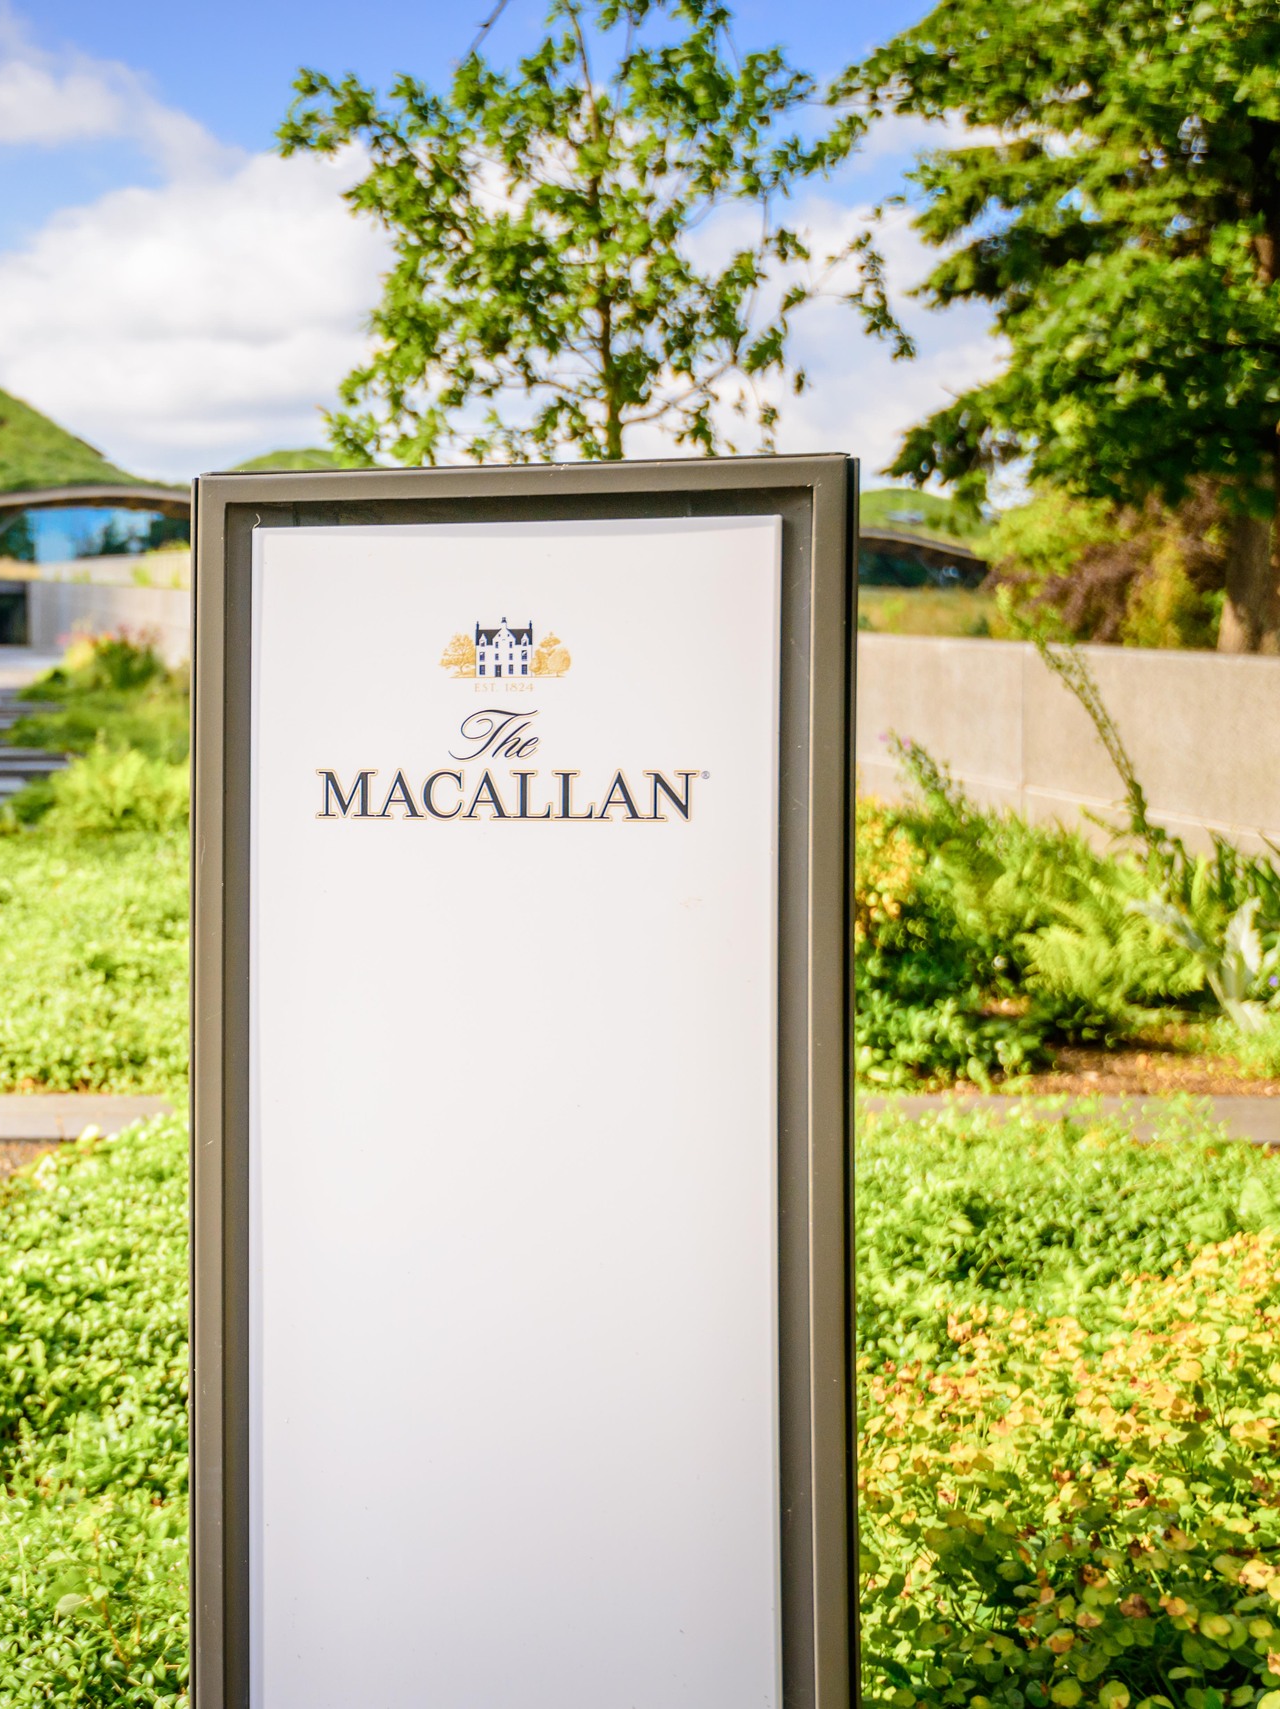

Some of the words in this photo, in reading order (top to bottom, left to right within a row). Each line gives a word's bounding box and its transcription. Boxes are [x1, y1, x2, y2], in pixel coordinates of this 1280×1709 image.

[504, 682, 535, 693] 1824
[448, 709, 540, 762] The
[315, 767, 701, 822] MACALLAN
